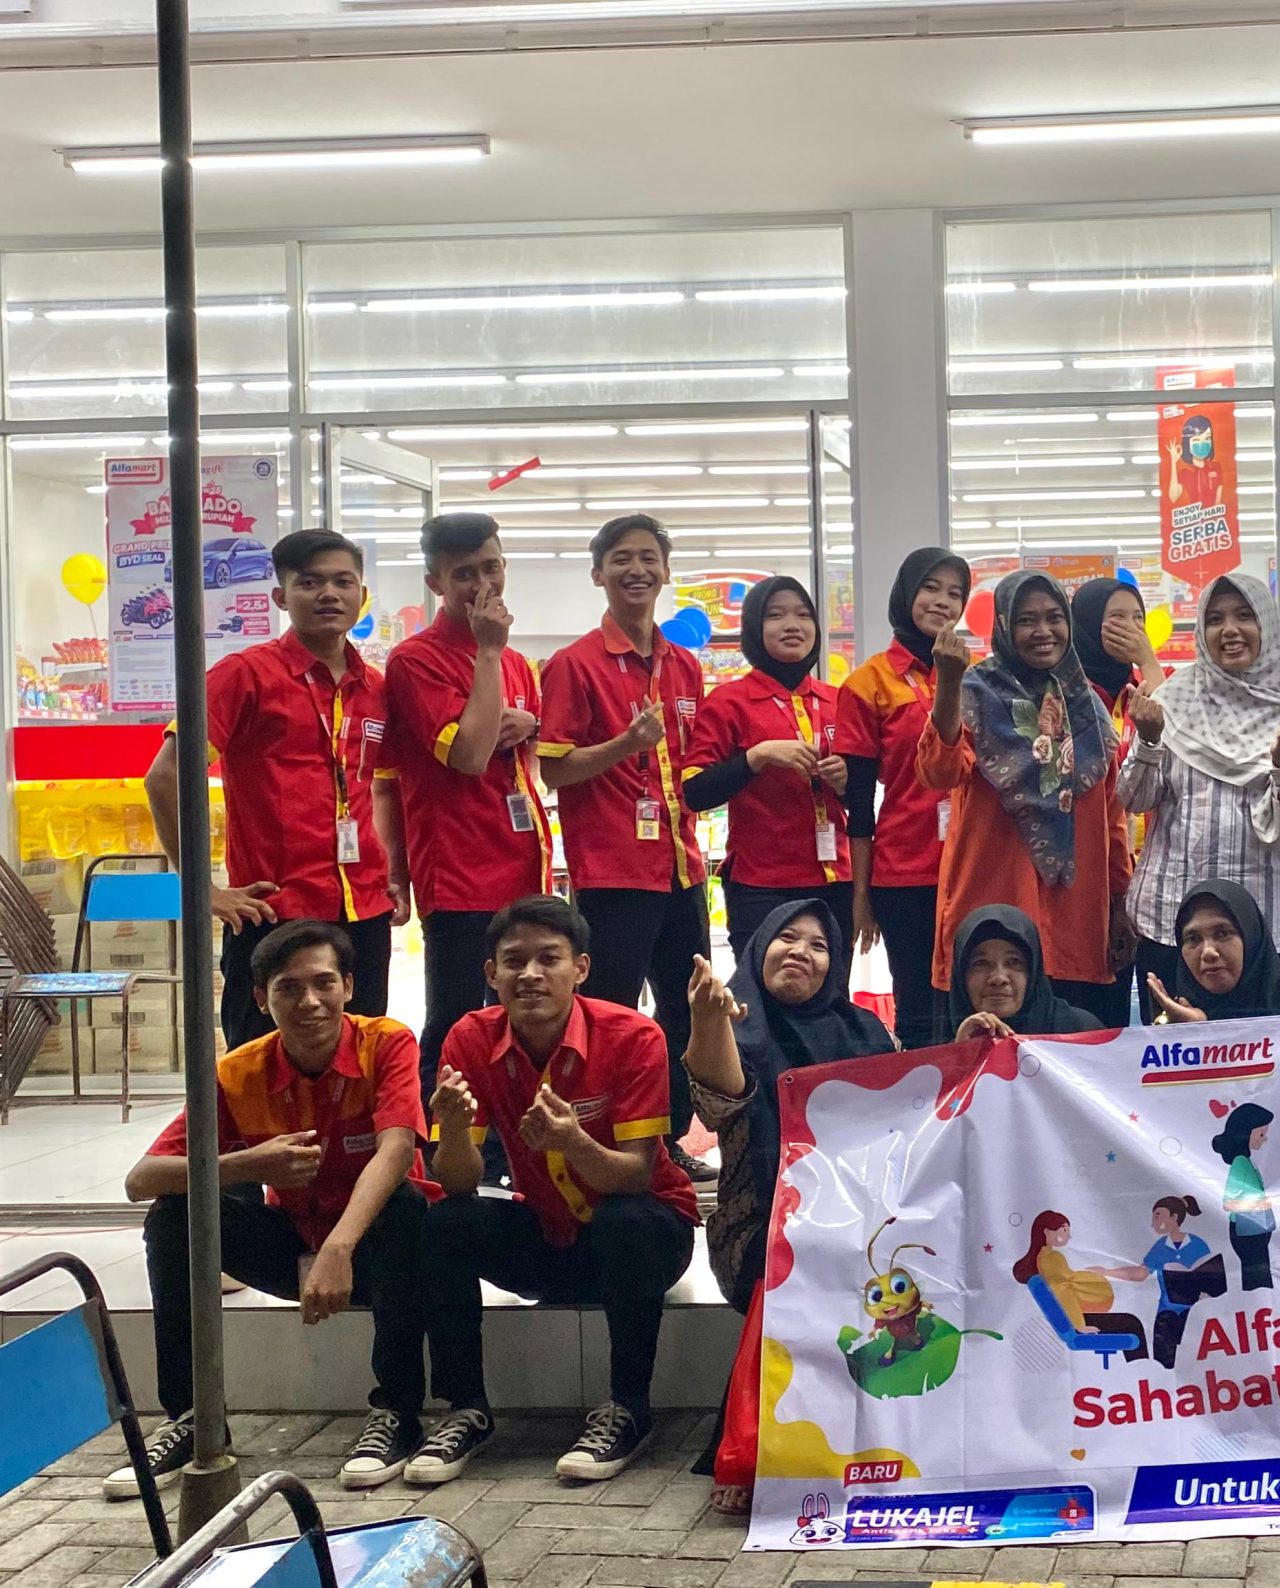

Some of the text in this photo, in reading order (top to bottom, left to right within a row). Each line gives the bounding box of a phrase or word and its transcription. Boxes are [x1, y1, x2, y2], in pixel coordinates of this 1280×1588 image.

[111, 463, 157, 474] Alfamart
[203, 499, 242, 514] ADO
[1173, 505, 1201, 518] ENJOY
[1174, 506, 1226, 526] SETIAP HARI
[1172, 520, 1228, 546] SERBA
[113, 540, 172, 554] GRAND PRIZ
[1170, 535, 1232, 560] GRATIS
[119, 553, 163, 567] BYD SEAL
[1140, 1037, 1274, 1068] Alfamart
[850, 1464, 898, 1481] BARU
[1174, 1477, 1280, 1506] Untuk
[853, 1505, 980, 1527] LUKAJEL
